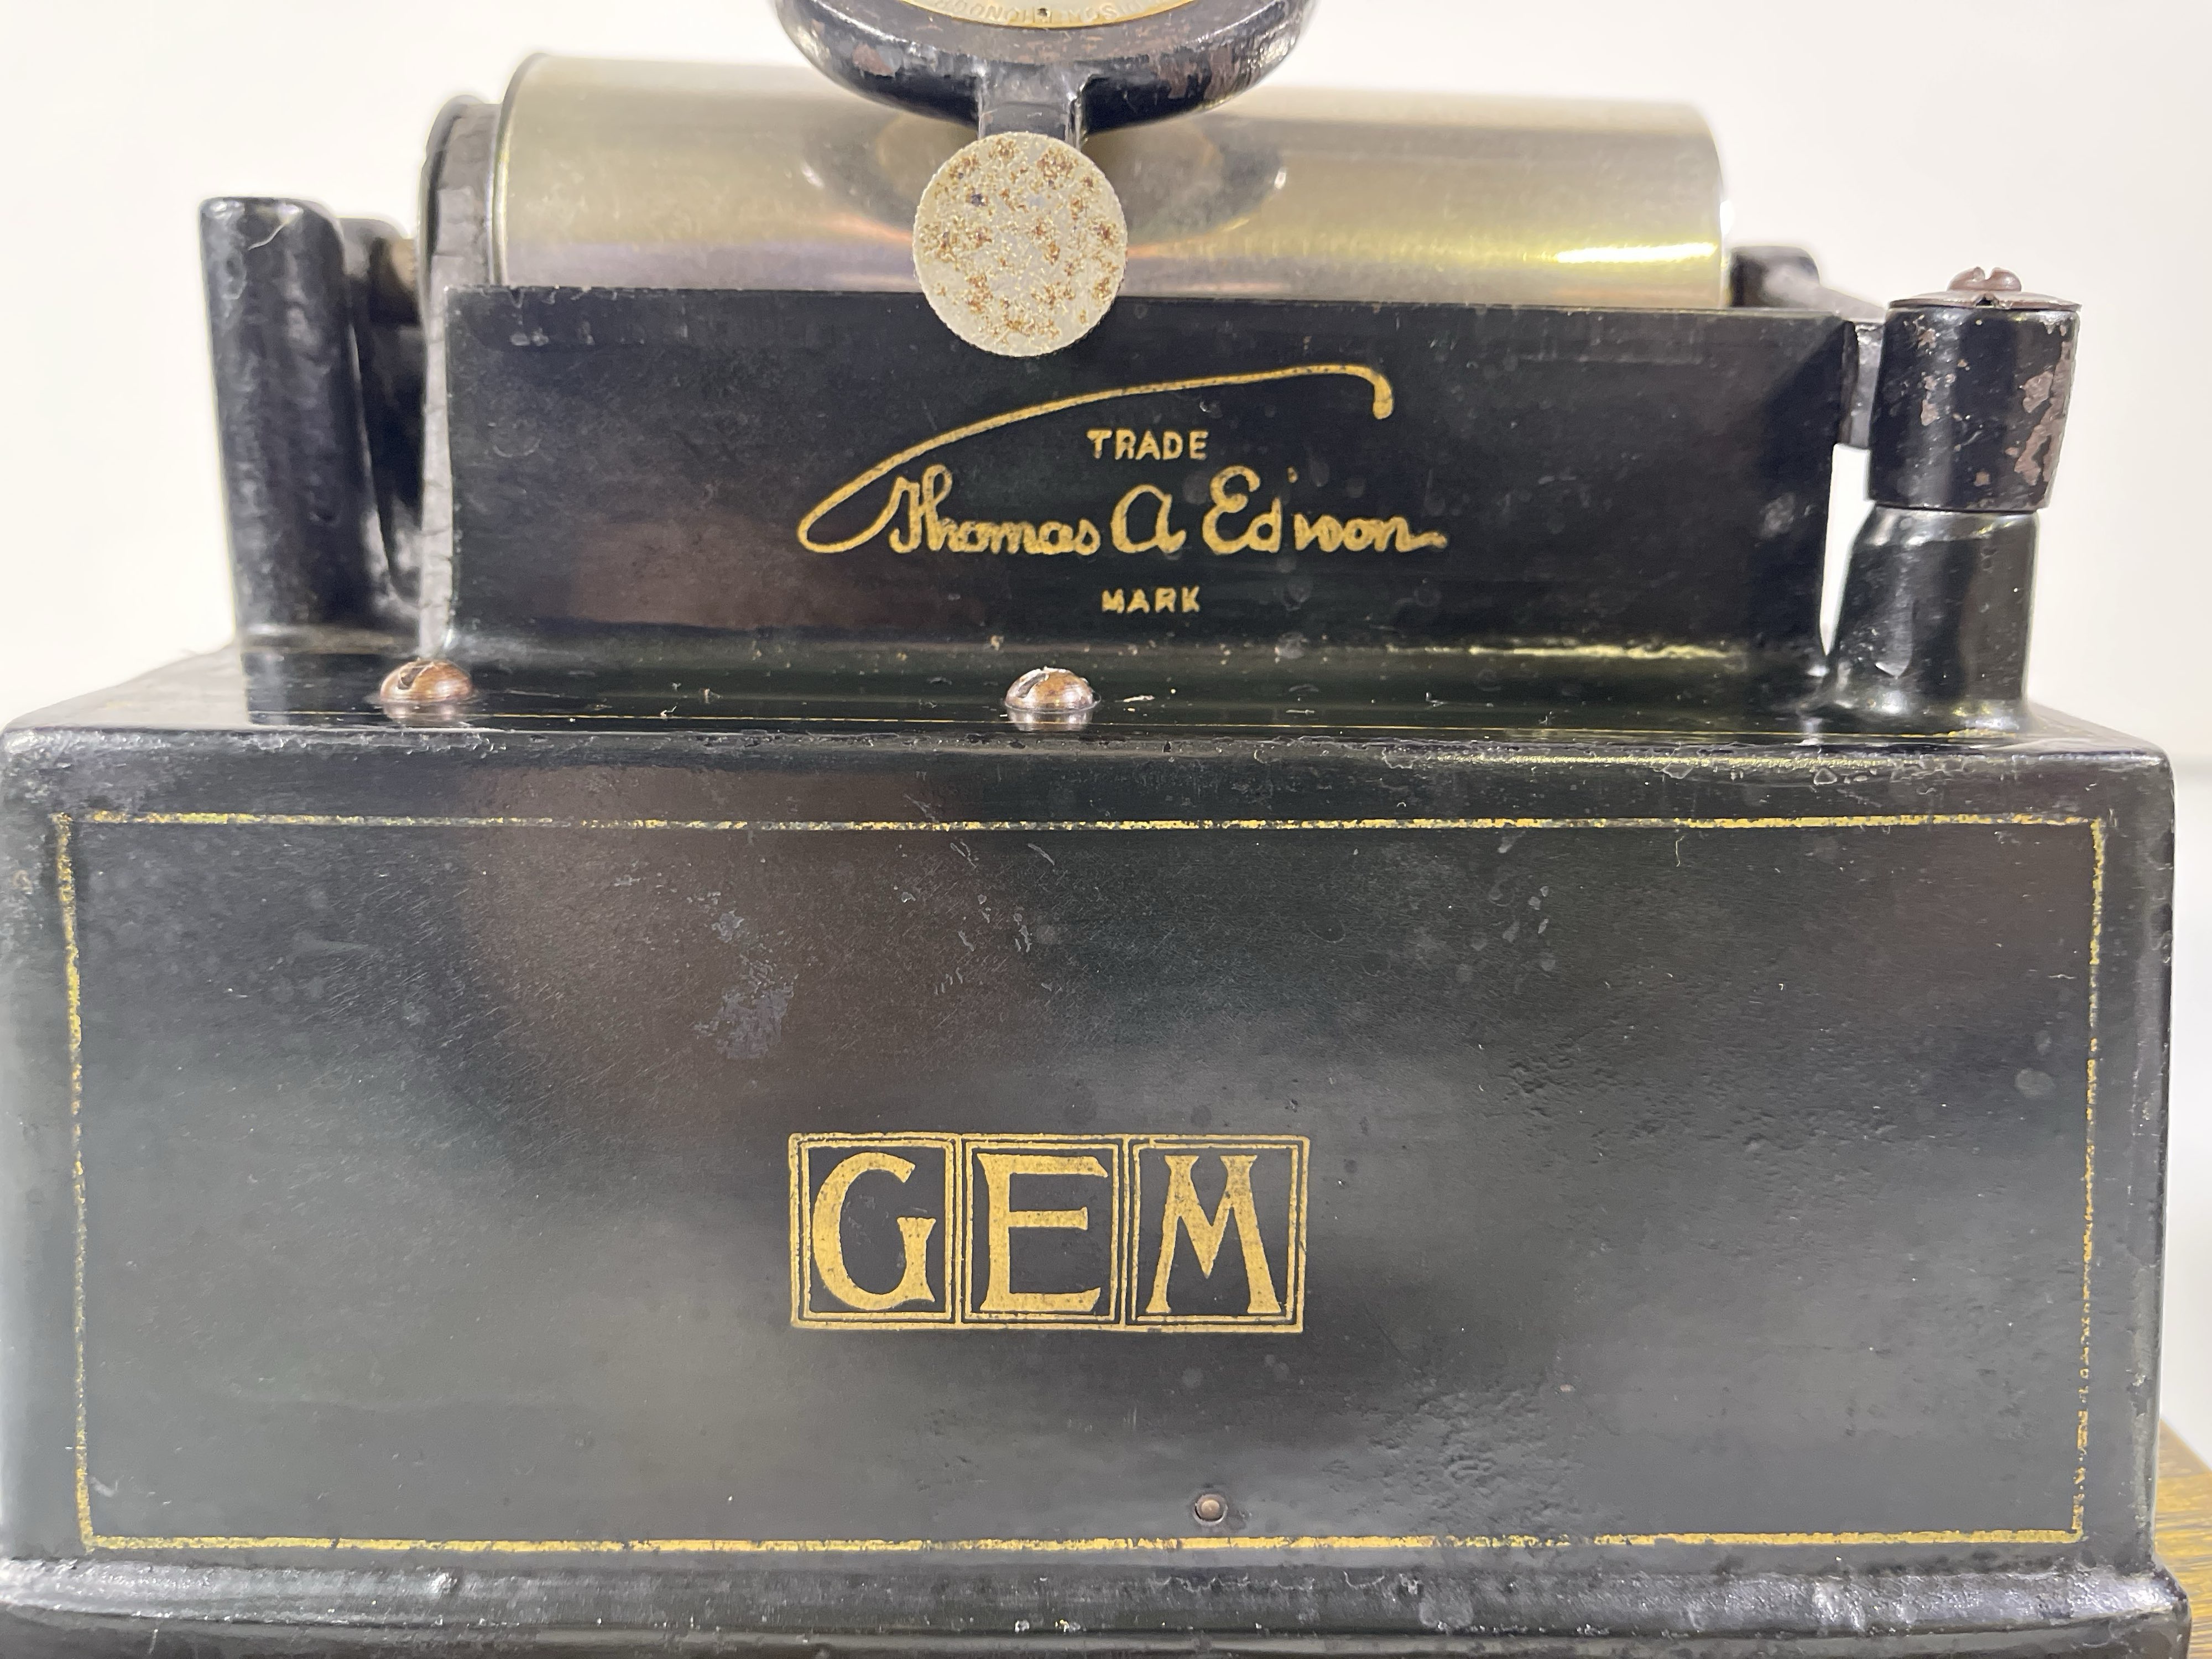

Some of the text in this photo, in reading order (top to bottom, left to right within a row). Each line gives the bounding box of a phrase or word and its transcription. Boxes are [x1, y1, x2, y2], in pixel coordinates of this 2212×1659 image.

[1086, 427, 1209, 461] TRADE
[797, 463, 1447, 555] Thomas A Edison
[1101, 586, 1201, 613] MARK
[813, 1151, 1281, 1314] GEM
